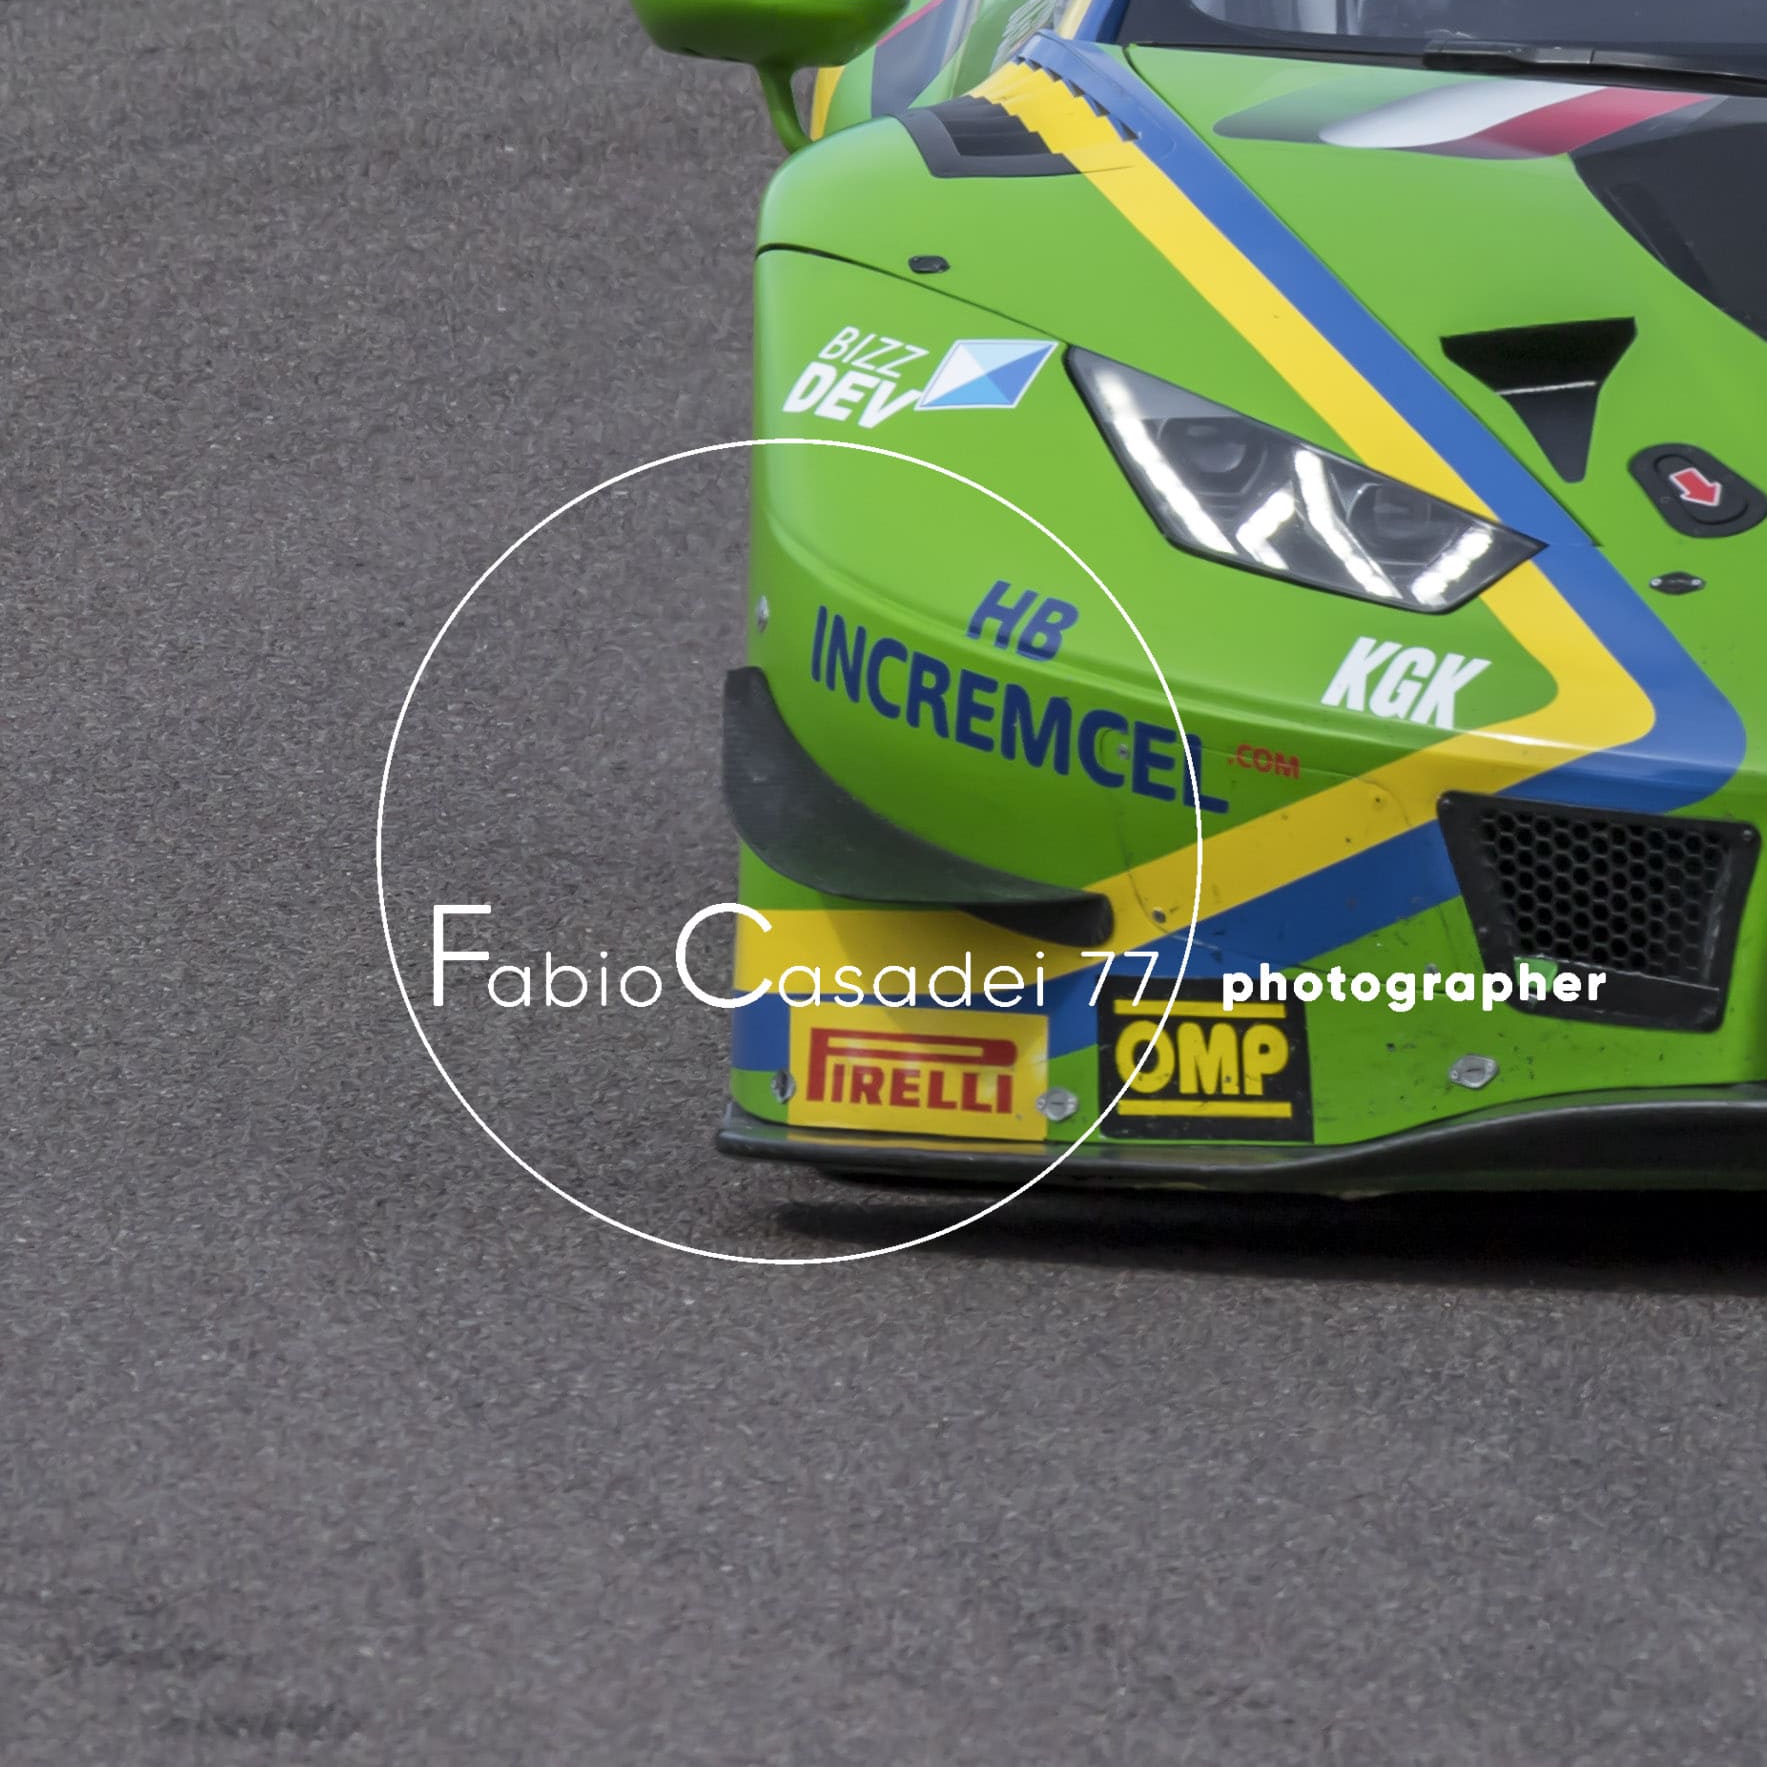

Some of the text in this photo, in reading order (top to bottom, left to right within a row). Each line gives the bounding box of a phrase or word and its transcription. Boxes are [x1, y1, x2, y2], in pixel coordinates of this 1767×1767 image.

[817, 325, 931, 379] BIZZ
[781, 360, 924, 430] DEV
[965, 579, 1080, 663] HB
[810, 604, 1230, 815] INCREMCEL
[1320, 635, 1492, 730] KGK
[806, 1026, 1019, 1115] PIRELLI
[1114, 1019, 1290, 1097] OMP
